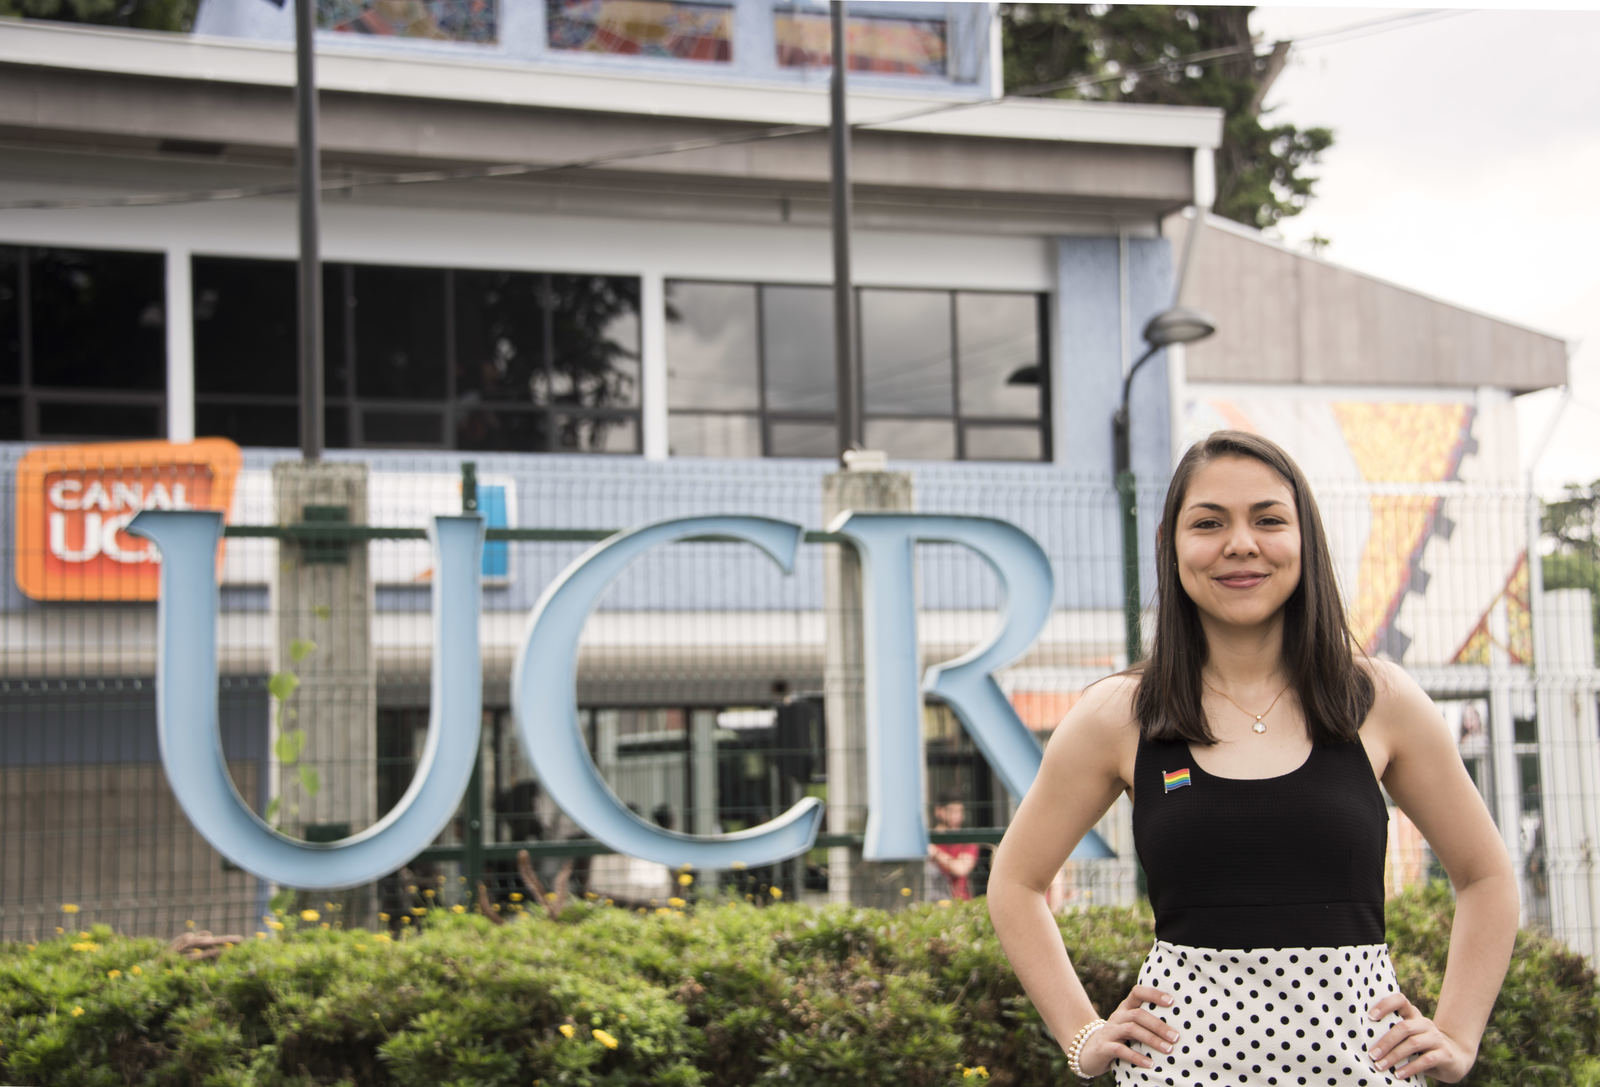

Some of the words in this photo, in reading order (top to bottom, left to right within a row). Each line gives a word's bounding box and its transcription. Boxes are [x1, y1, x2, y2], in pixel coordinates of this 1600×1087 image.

[49, 479, 192, 510] CANAL
[49, 511, 163, 563] UC
[126, 510, 1117, 889] UCR
